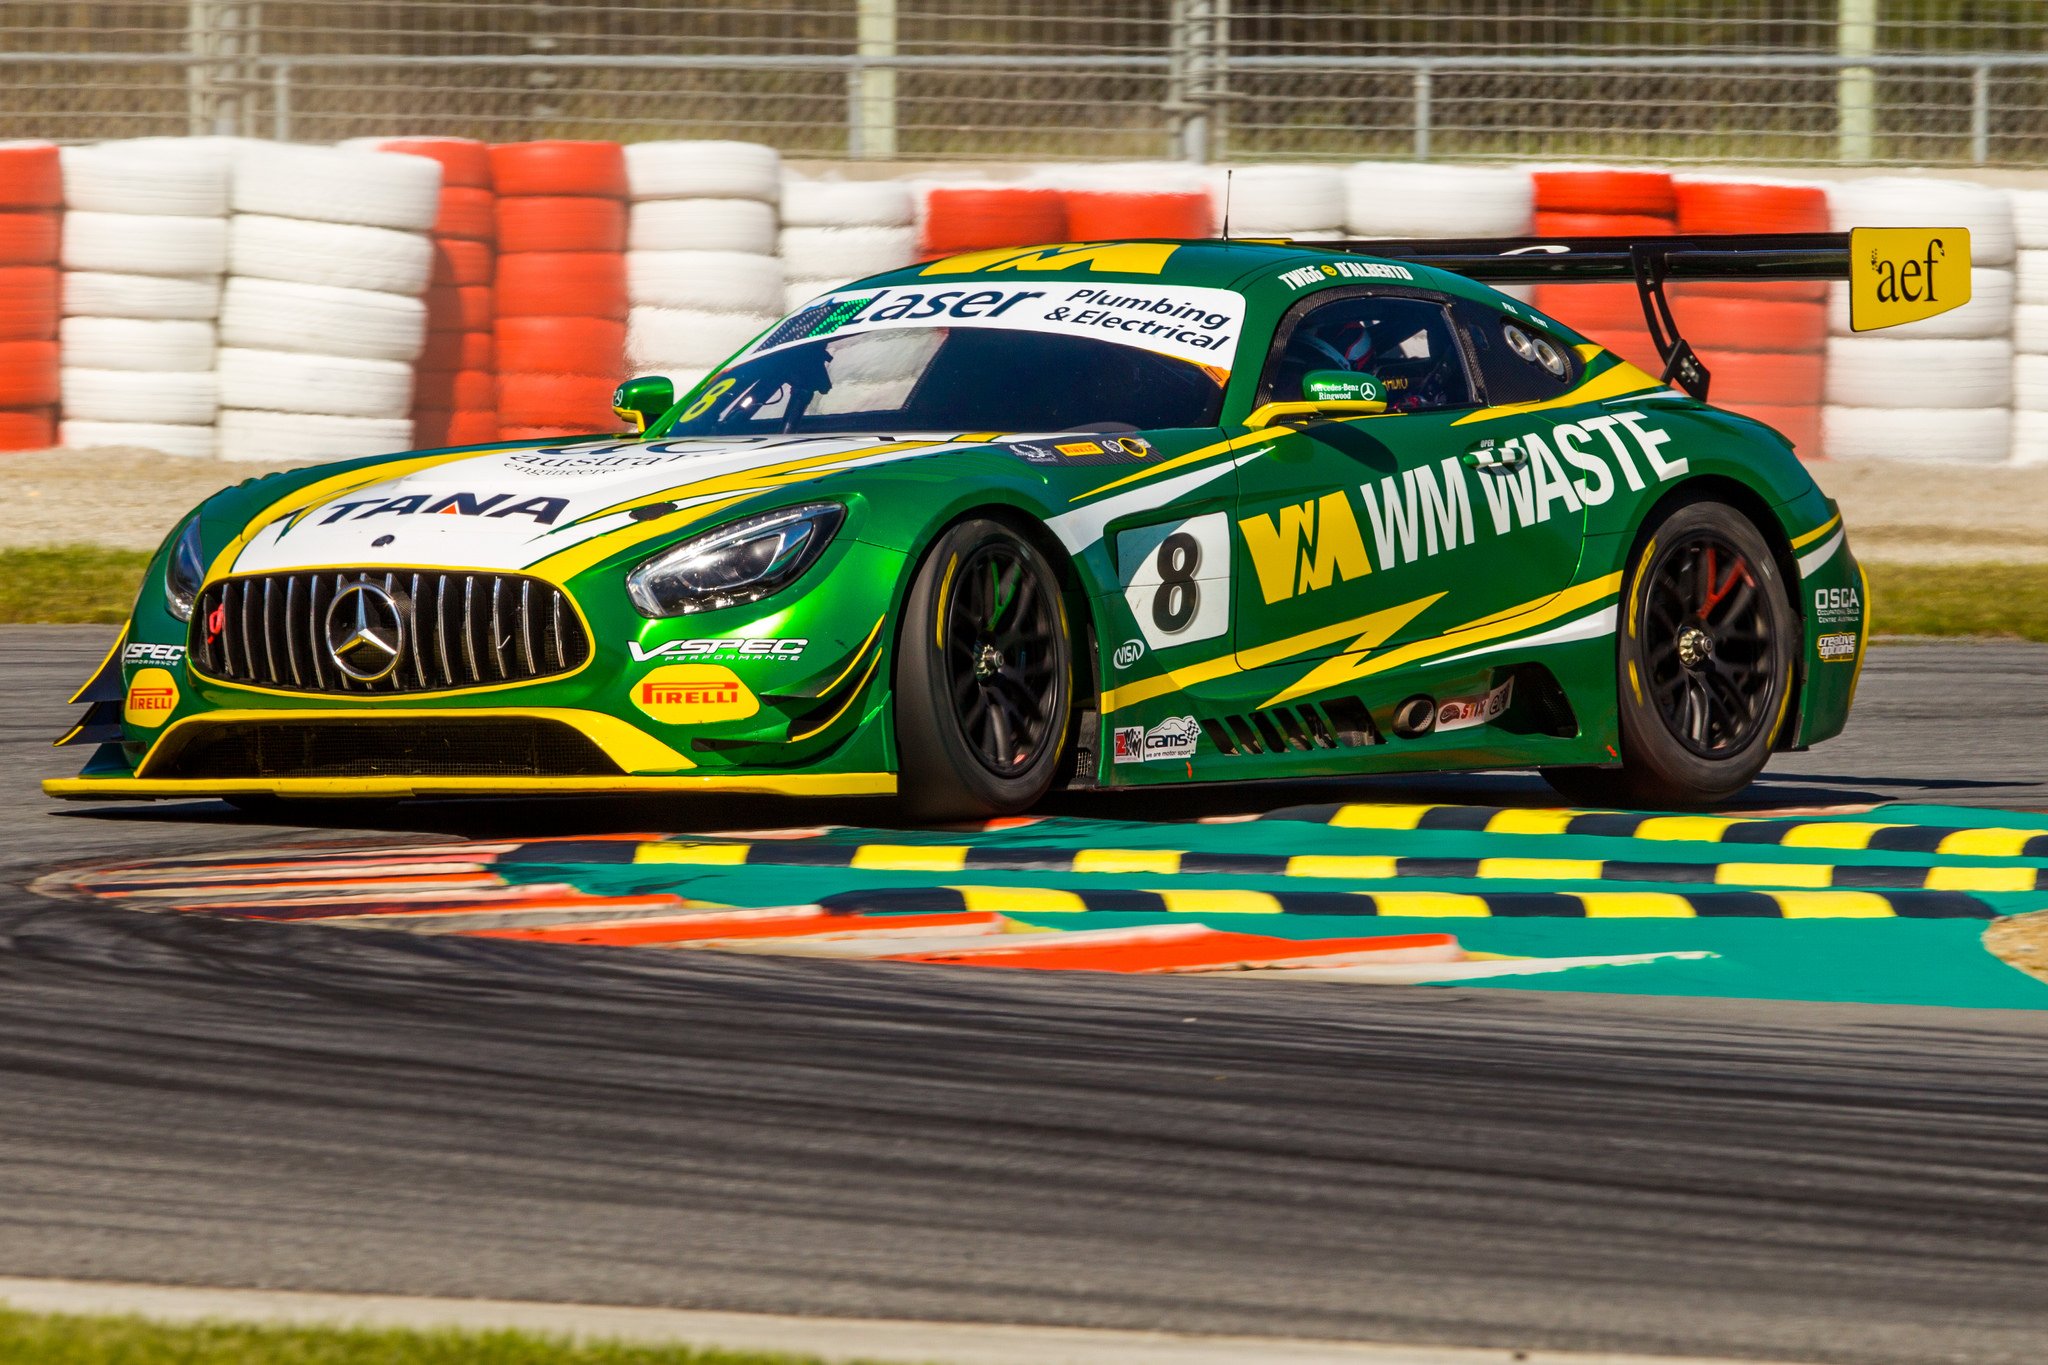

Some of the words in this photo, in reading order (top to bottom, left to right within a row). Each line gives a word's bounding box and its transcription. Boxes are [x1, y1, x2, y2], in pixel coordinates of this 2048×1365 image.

[1278, 265, 1326, 290] TWIGG
[1333, 261, 1413, 280] D'ALBERTO
[1872, 238, 1945, 303] aef
[849, 289, 1047, 325] Laser
[1065, 289, 1231, 330] Plumbing
[1044, 306, 1070, 321] &
[1070, 310, 1230, 351] Electrical
[679, 378, 736, 423] 8
[1310, 383, 1359, 392] Mercedes-Benz
[1318, 392, 1351, 400] Ringwood
[1480, 439, 1495, 448] OPEN
[1360, 456, 1475, 571] WM
[1474, 411, 1689, 536] WASTE
[317, 492, 570, 526] TANA
[1152, 532, 1203, 634] 8
[1815, 588, 1859, 609] OSCA
[130, 688, 172, 710] PIRELLI
[643, 682, 739, 704] PIRELLI
[1145, 733, 1188, 749] cams
